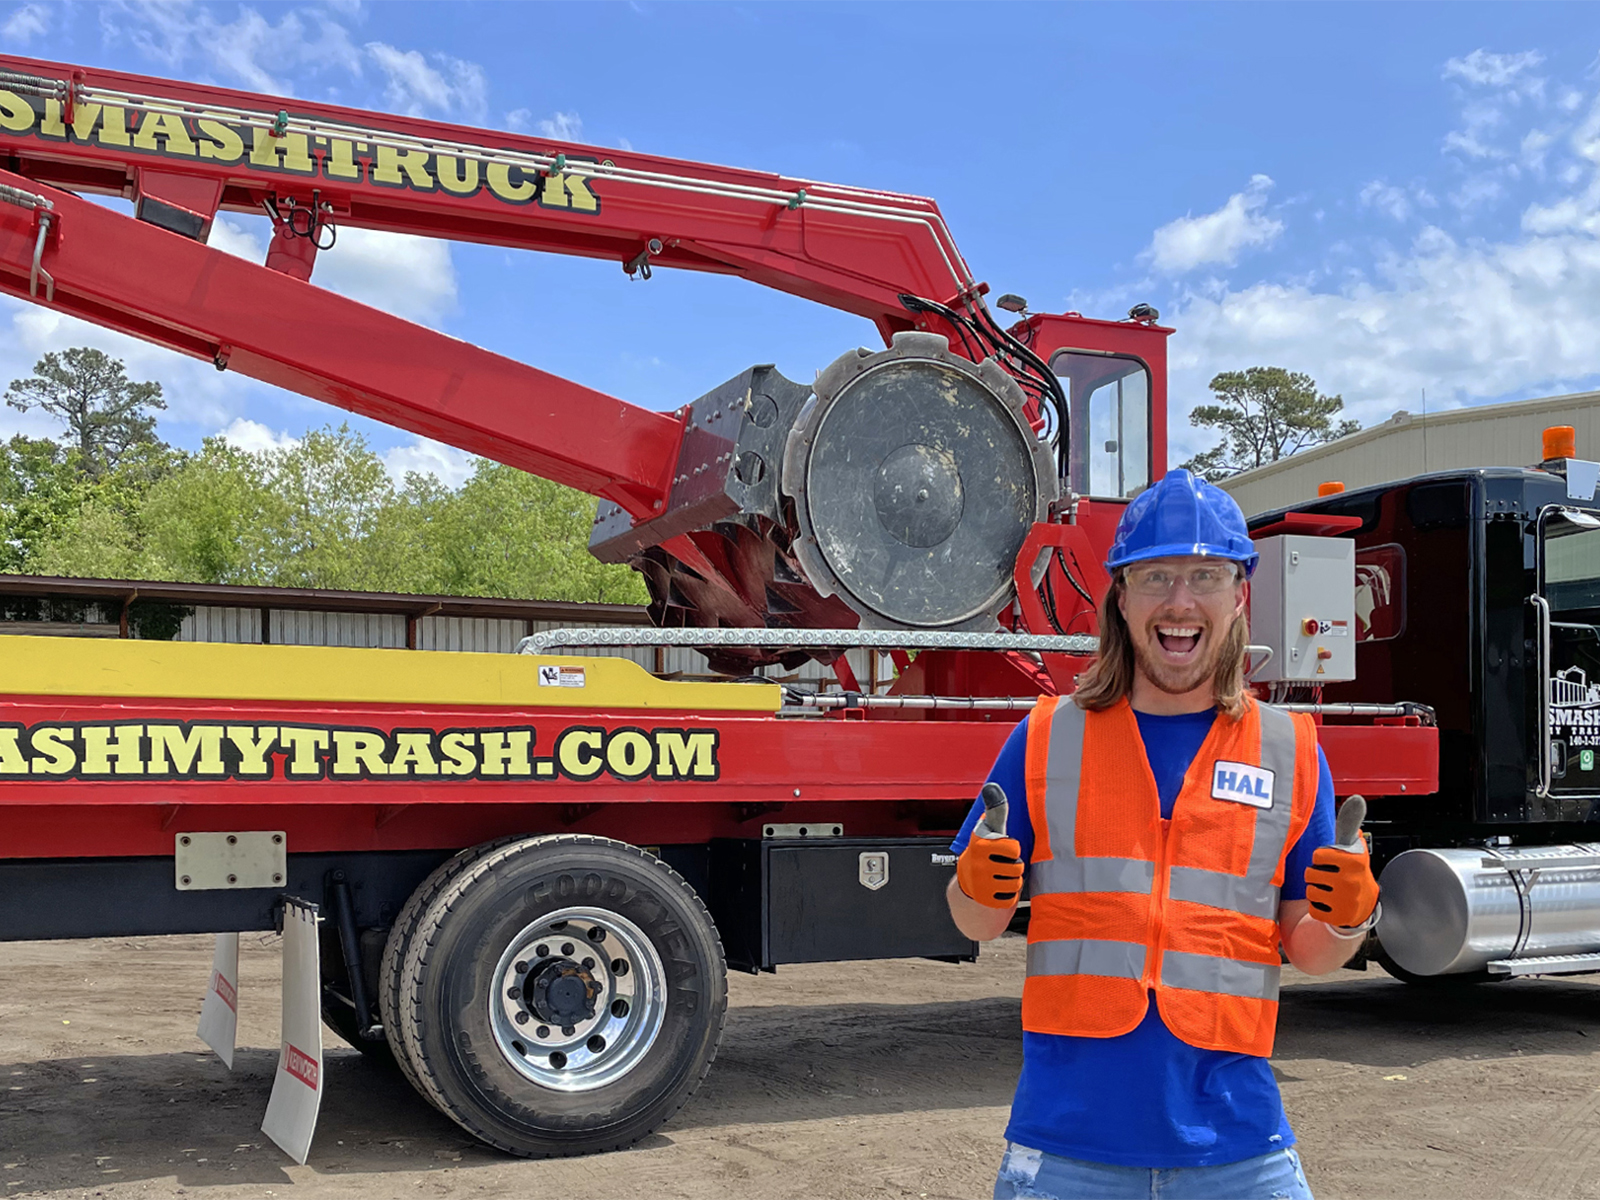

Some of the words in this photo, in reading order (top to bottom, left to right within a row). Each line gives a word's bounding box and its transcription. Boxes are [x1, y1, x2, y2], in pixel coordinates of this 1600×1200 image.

[0, 89, 597, 211] SMASHTRUCK
[0, 724, 717, 777] ASHMYTRASH.COM
[1217, 770, 1270, 799] HAL
